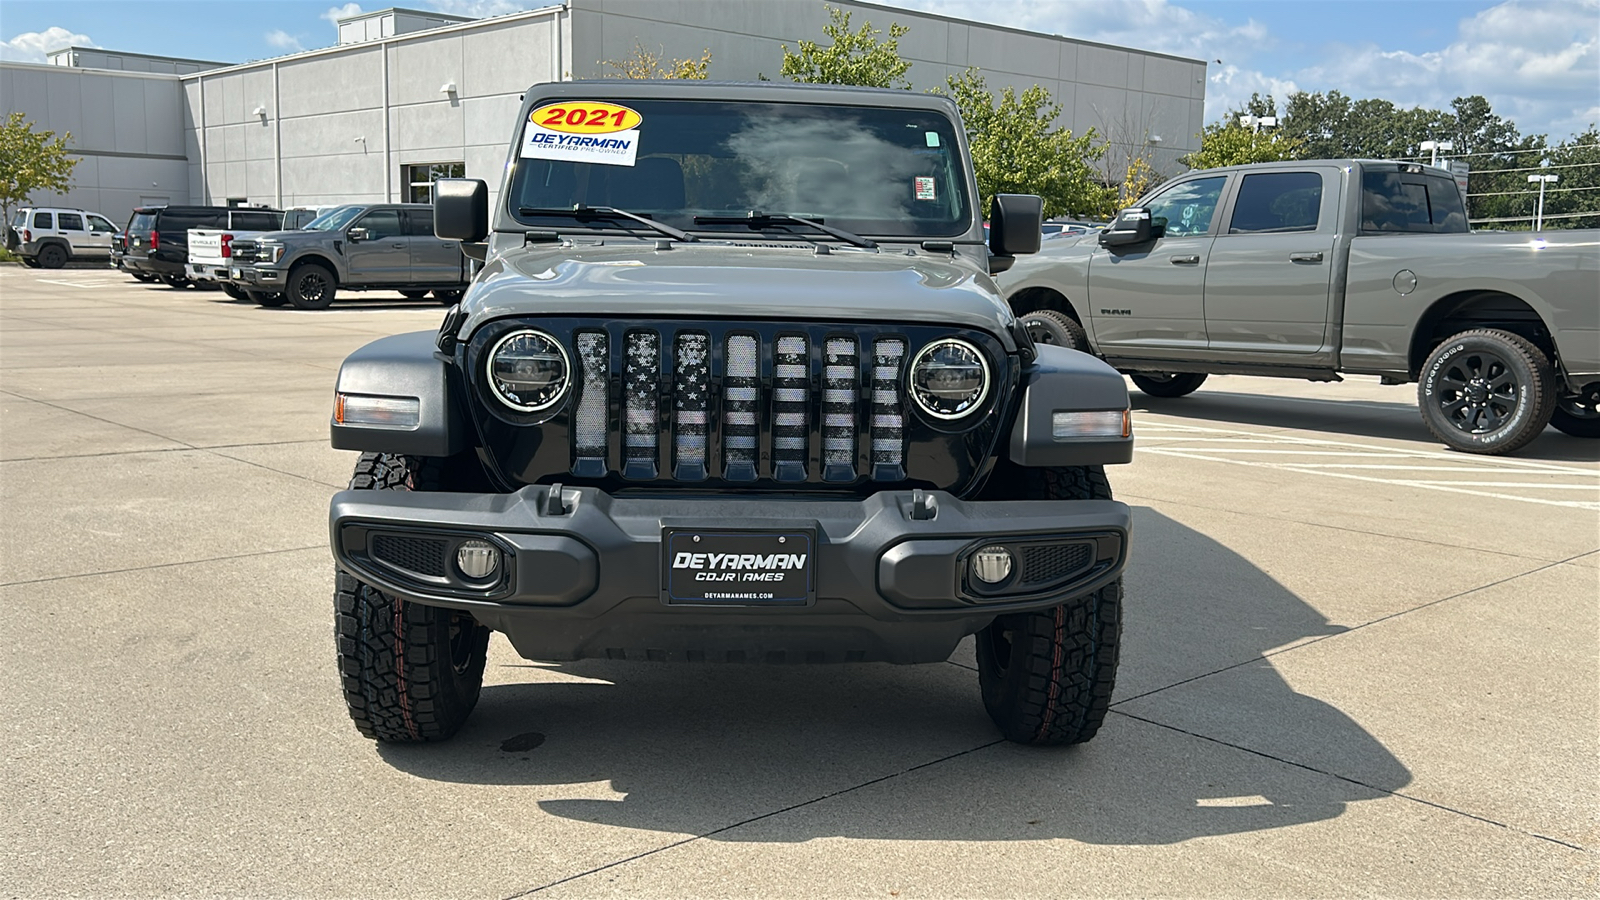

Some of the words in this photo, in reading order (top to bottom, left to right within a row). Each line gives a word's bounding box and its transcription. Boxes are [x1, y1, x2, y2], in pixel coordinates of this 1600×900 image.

[542, 108, 627, 126] 2021
[531, 133, 631, 149] DEYARMAN
[537, 143, 579, 151] CERTIFIED
[580, 147, 627, 155] PRE-OWNED
[673, 553, 806, 569] DEYARMAN
[695, 572, 736, 582] CDJR
[742, 572, 785, 582] AMES
